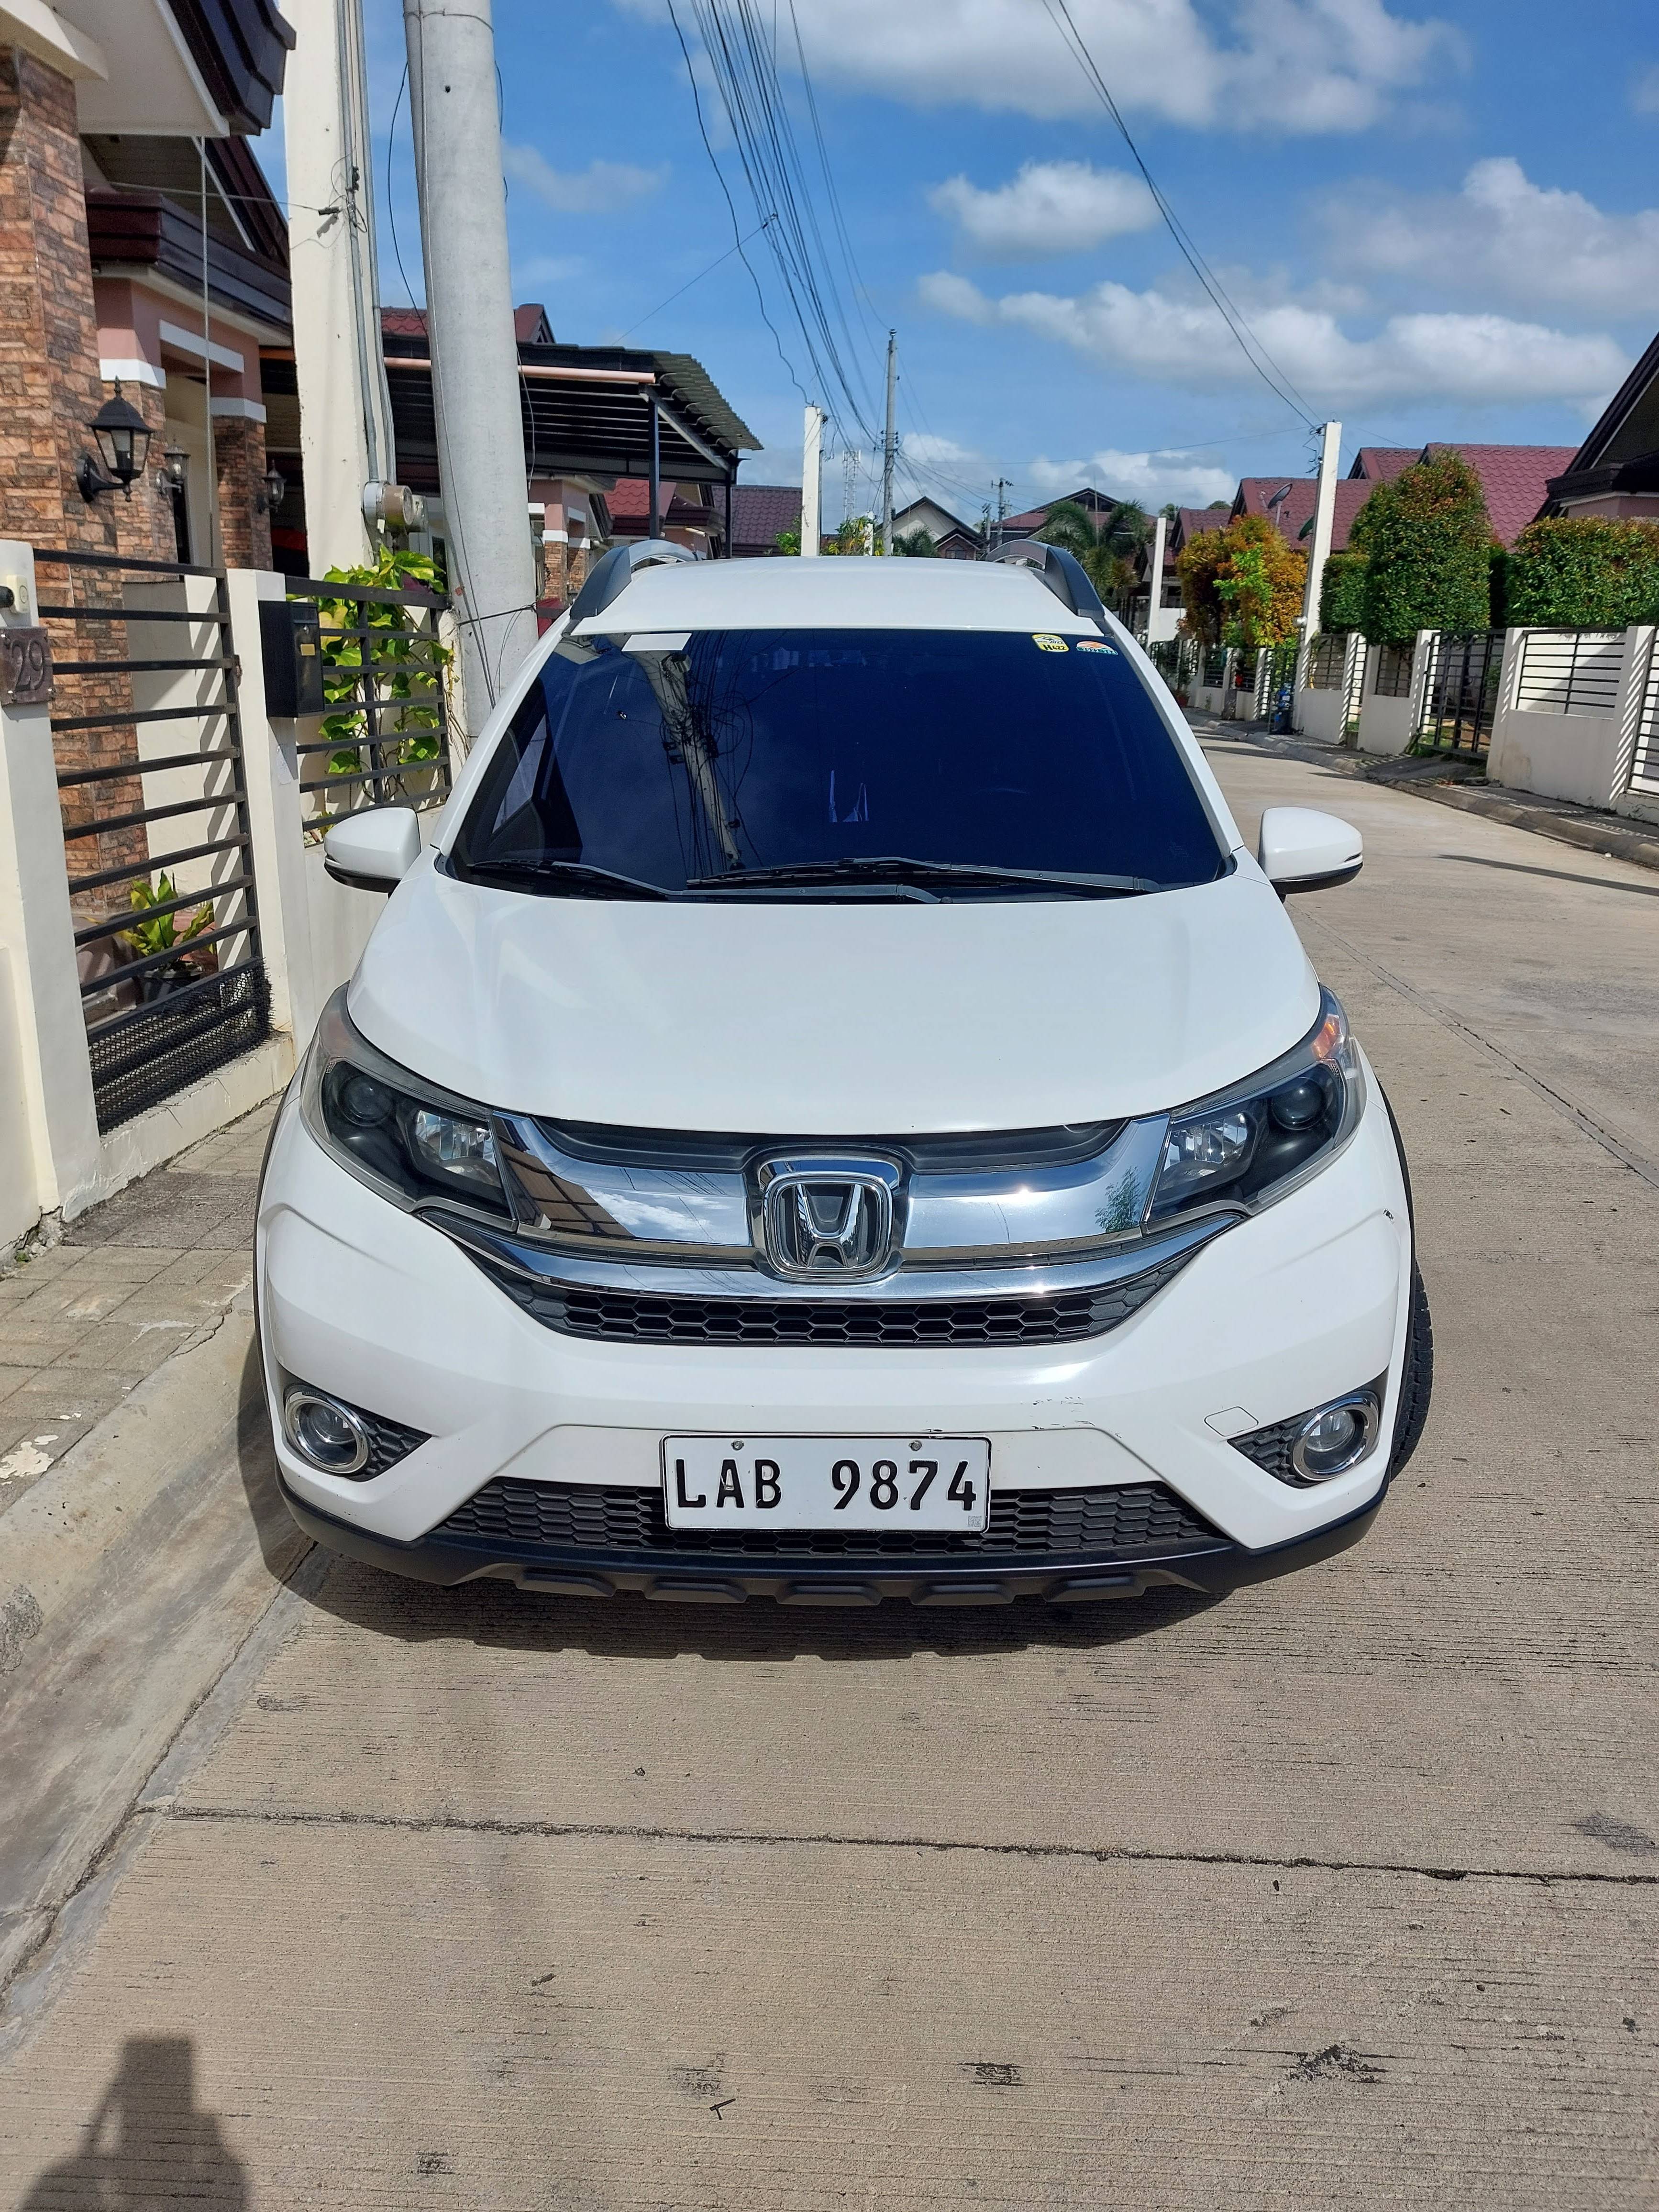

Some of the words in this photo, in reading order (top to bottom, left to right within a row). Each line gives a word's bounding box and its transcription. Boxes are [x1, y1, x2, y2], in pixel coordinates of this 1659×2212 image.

[11, 641, 45, 692] 29
[675, 1459, 781, 1508] LAB
[831, 1460, 976, 1511] 9874
